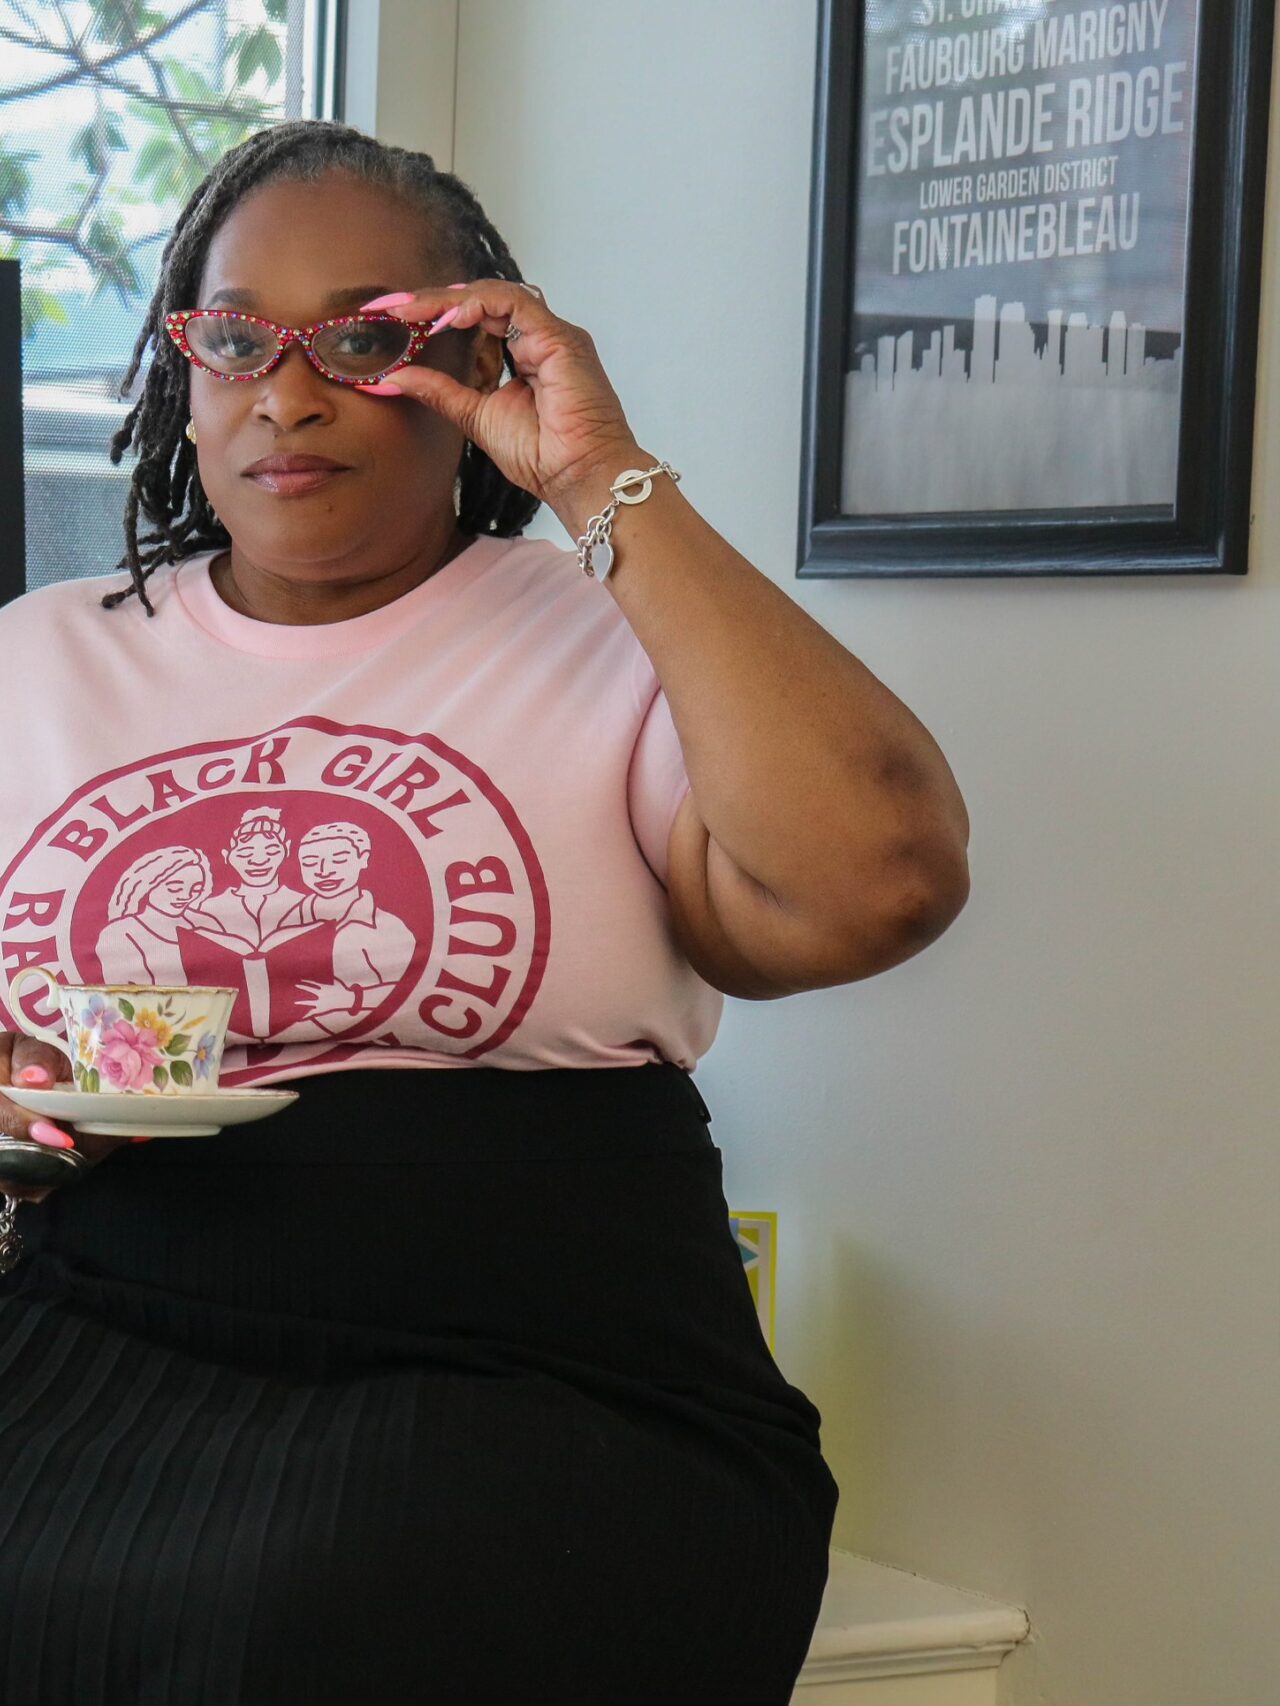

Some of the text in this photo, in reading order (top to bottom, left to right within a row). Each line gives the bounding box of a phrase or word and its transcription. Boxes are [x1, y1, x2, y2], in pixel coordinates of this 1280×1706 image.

[886, 0, 1170, 95] FAUBOURG MARIGNY
[867, 60, 1187, 177] ESPLANDE RIDGE
[892, 192, 1141, 275] FONTAINEBLEAU
[920, 155, 1119, 210] LOWER GARDEN DISTRICT
[2, 736, 472, 1041] RAD BLACK GIRL
[418, 855, 518, 1040] CLUB
